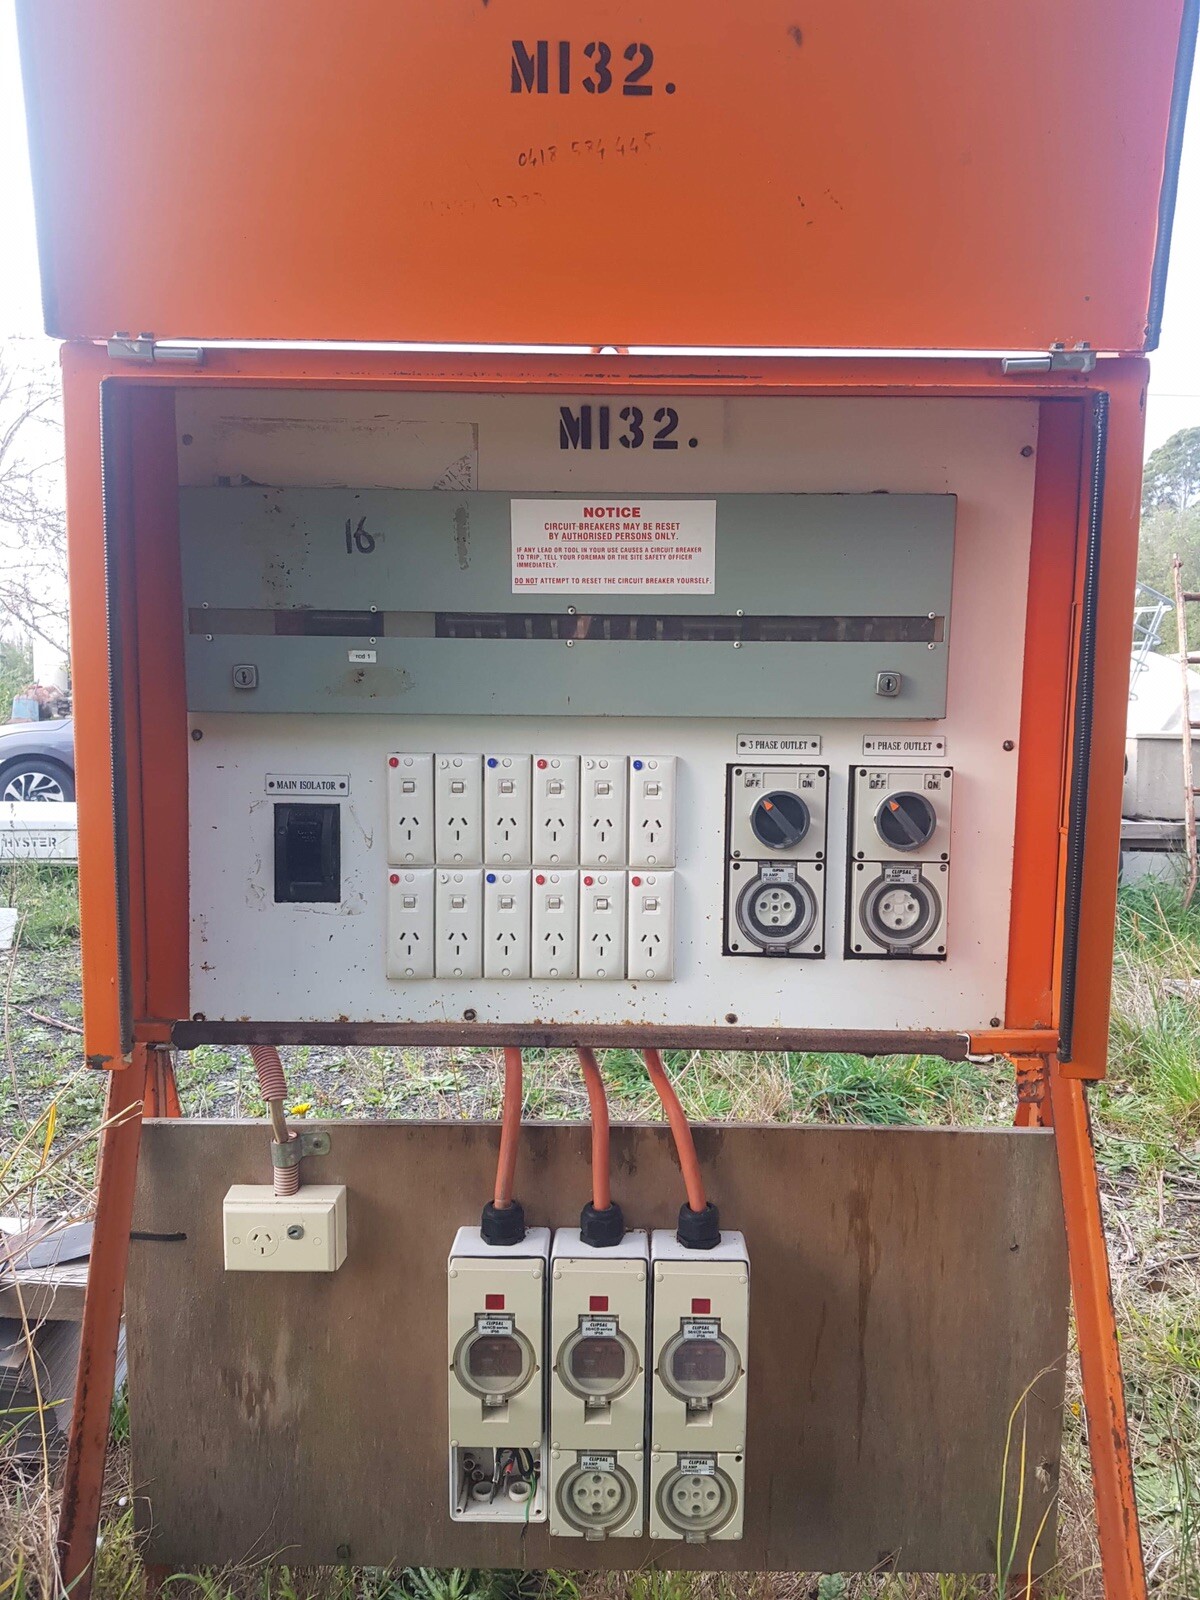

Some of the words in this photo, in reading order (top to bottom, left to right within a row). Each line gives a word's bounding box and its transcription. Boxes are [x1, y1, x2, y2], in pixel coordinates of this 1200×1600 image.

[583, 506, 641, 519] NOTICE
[622, 522, 641, 531] MAY
[643, 522, 653, 531] BE
[655, 522, 681, 531] RESET
[345, 516, 376, 554] 16
[548, 532, 559, 540] BY
[561, 532, 613, 540] AUTHORISED
[615, 532, 653, 540] PERSONS
[654, 532, 679, 540] ONLY.
[748, 740, 754, 750] 3
[755, 740, 779, 750] PHASE
[780, 740, 808, 750] OUTLET
[877, 741, 902, 751] PHASE
[903, 741, 933, 751] OUTLET
[276, 780, 297, 791] MAIN
[299, 780, 337, 791] ISOLATOR
[745, 779, 761, 788] OFF
[802, 780, 813, 788] ON
[869, 780, 886, 789] OFF
[927, 780, 939, 789] ON
[4, 837, 57, 848] HYSTER
